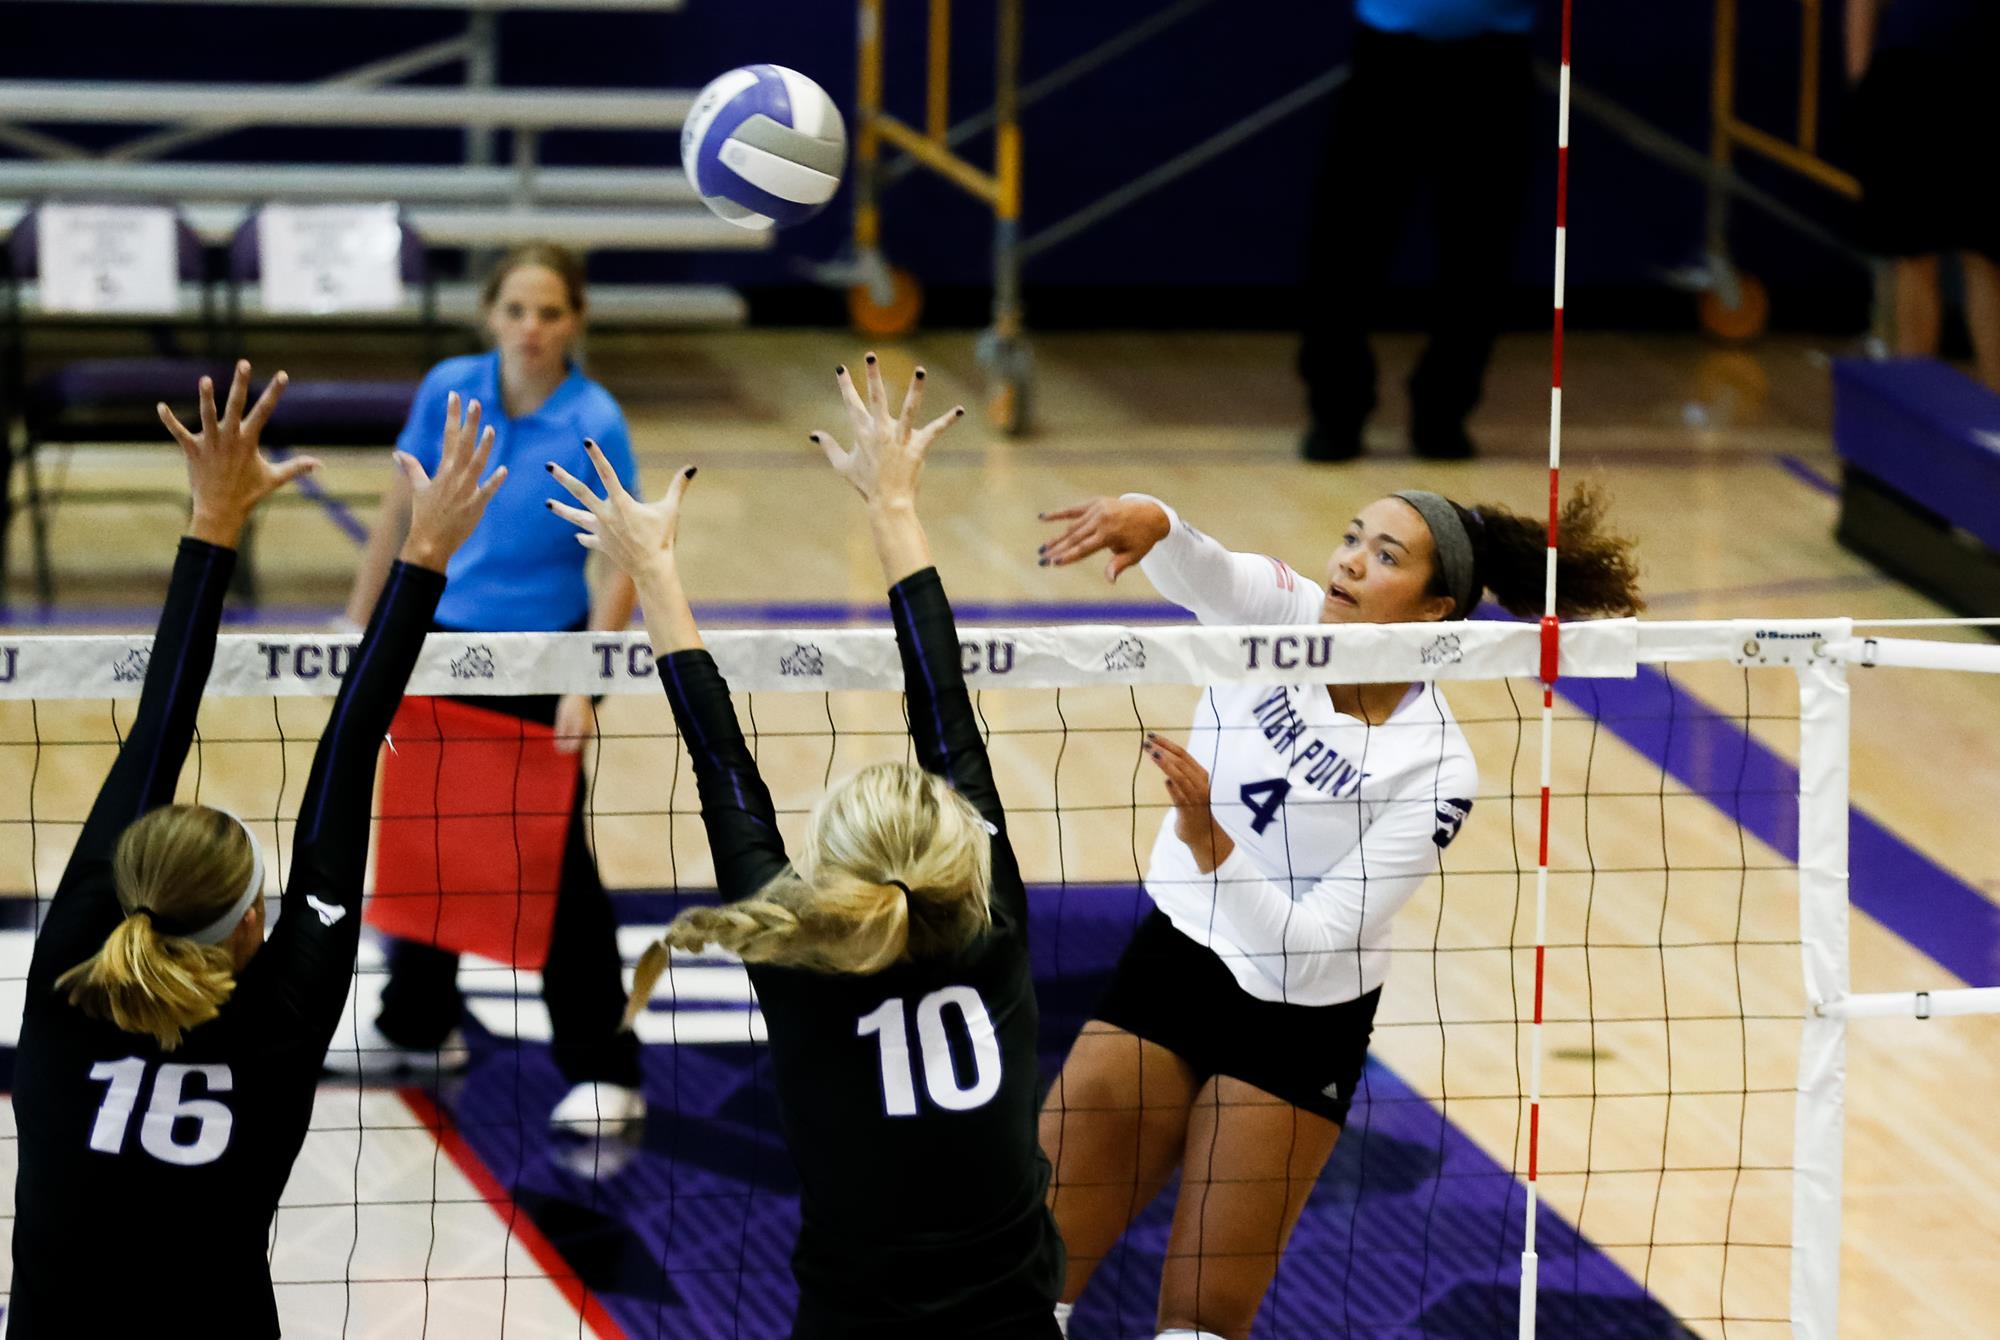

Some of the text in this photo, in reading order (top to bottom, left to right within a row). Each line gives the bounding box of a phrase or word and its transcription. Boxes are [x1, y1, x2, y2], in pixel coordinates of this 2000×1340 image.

[258, 643, 359, 680] TCU
[592, 641, 656, 680] TC
[959, 638, 1016, 675] CU
[1240, 633, 1334, 670] TCU
[1240, 777, 1291, 836] 4
[857, 984, 1002, 1116] 10
[89, 1055, 234, 1166] 16
